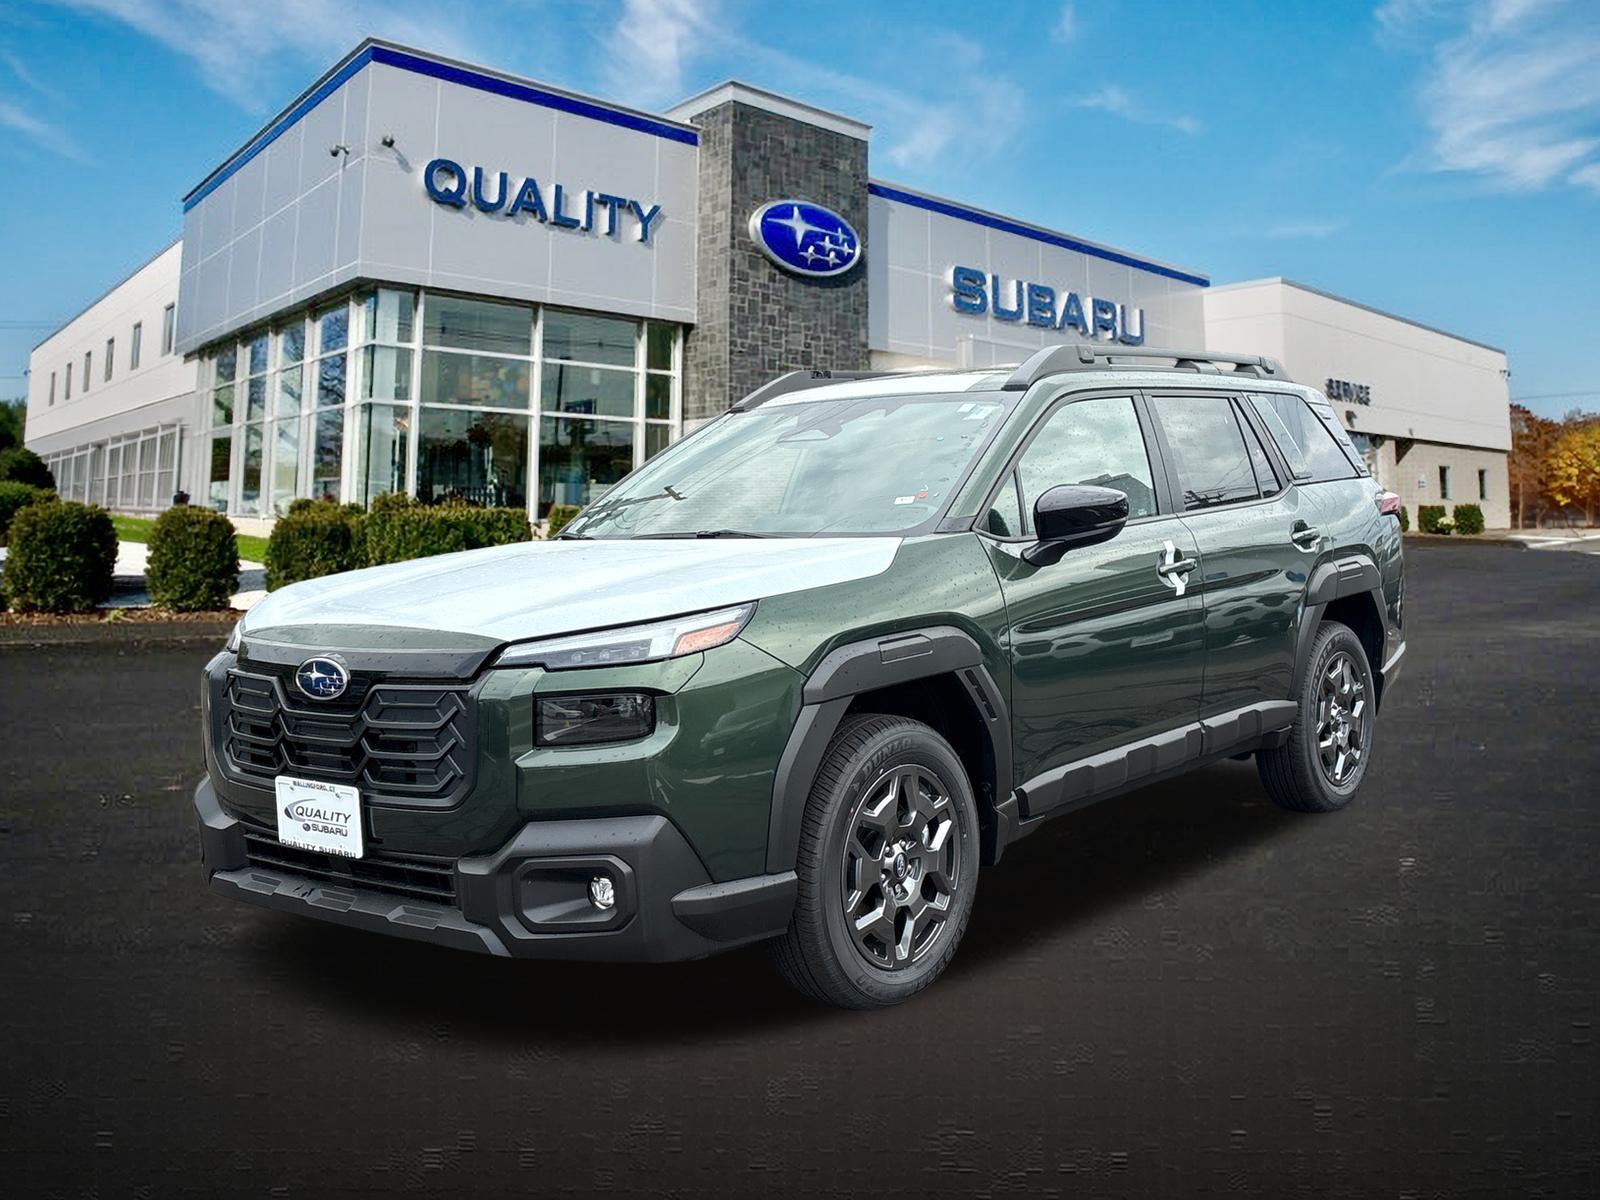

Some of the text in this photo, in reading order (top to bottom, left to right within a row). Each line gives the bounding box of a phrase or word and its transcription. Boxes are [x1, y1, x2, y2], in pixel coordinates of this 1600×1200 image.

[423, 158, 662, 242] QUALITY
[947, 265, 1145, 346] SUBARU
[295, 805, 352, 824] QUALITY
[311, 823, 348, 837] SUBARU
[281, 838, 317, 852] QUALITY
